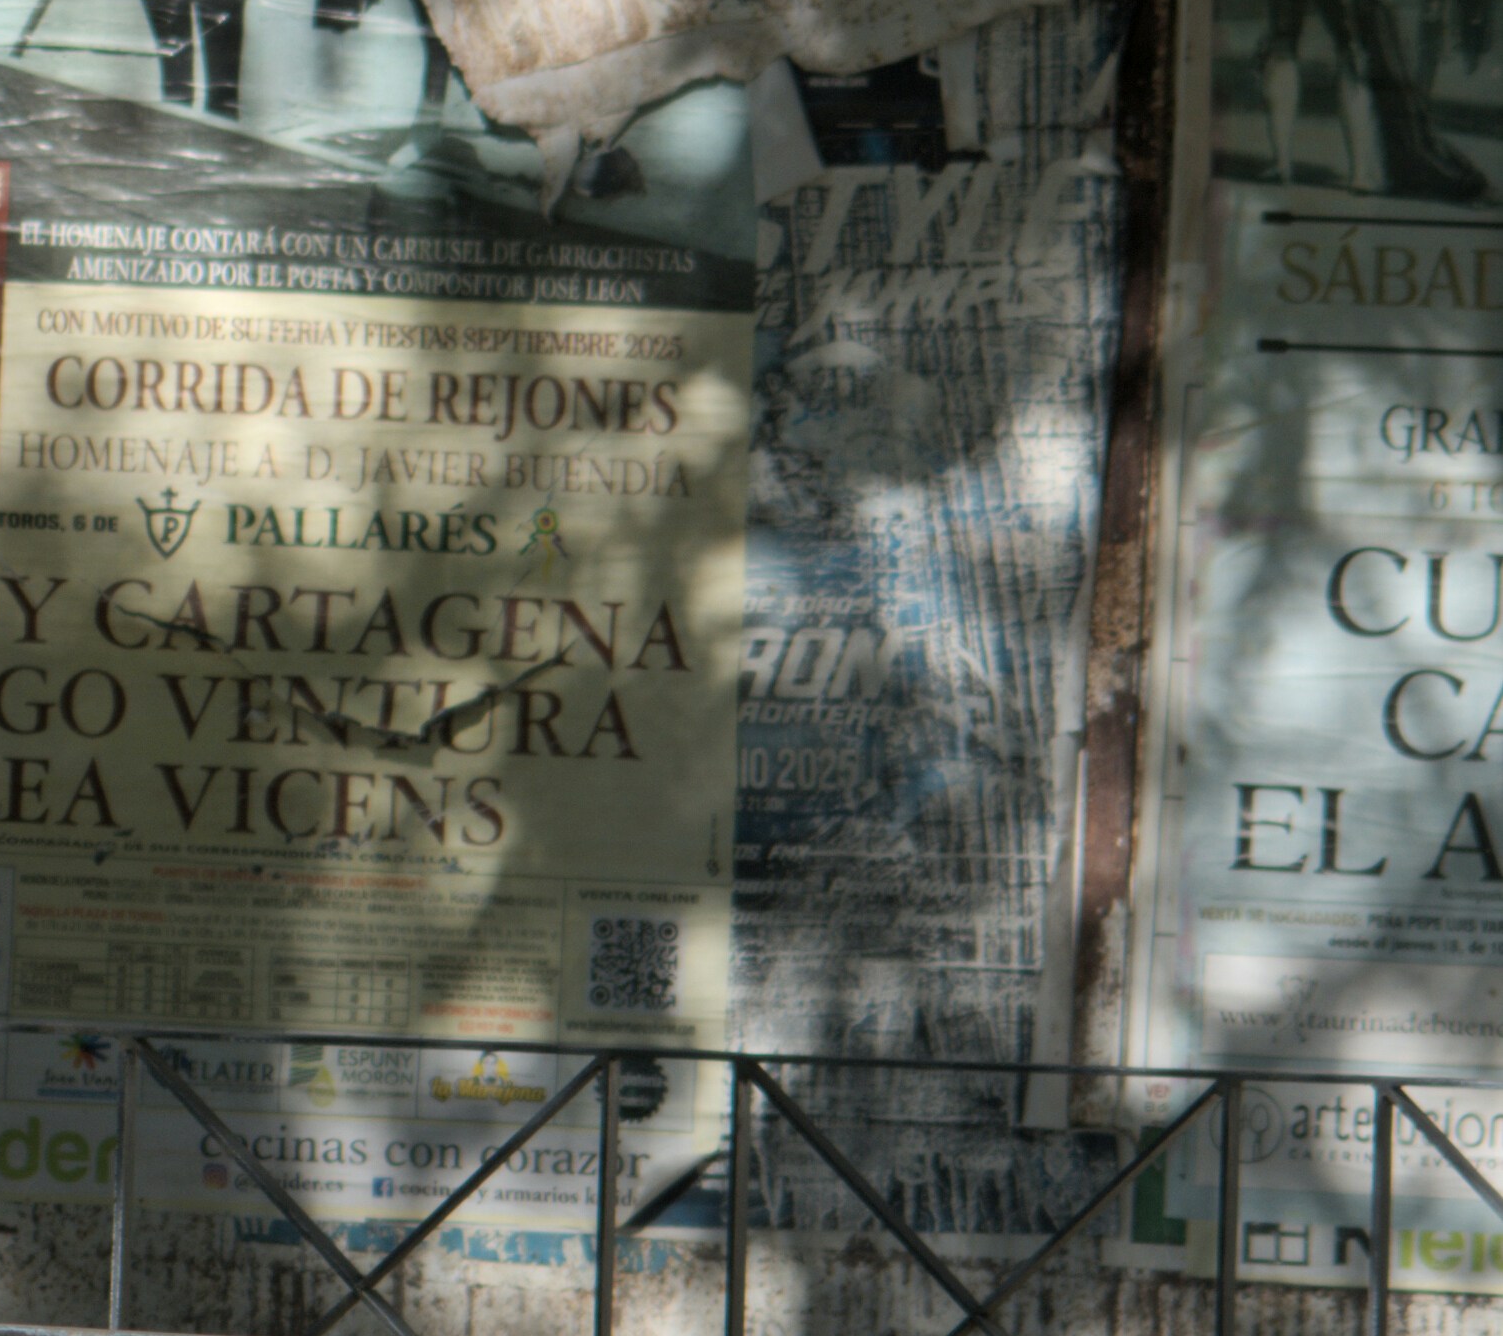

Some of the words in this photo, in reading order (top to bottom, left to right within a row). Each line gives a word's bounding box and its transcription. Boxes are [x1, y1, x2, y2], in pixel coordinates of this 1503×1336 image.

[20, 218, 43, 245] EL
[49, 220, 165, 255] HOMENAJE
[171, 221, 275, 255] CONTARÁ
[281, 231, 329, 257] CON
[333, 233, 369, 259] UN
[373, 234, 485, 264] CARRUSEL
[493, 240, 522, 265] DE
[526, 242, 695, 273] GARROCHISTAS
[67, 256, 203, 282] AMENIZADO
[207, 259, 252, 284] POR
[257, 261, 281, 286] EL
[287, 265, 358, 290] POETA
[362, 267, 379, 291] Y
[383, 268, 527, 299] COMPOSITOR
[532, 277, 580, 304] JOSÉ
[586, 277, 642, 303] LEÓN
[36, 308, 85, 334] CON
[91, 311, 190, 339] MOTIVO
[194, 316, 226, 340] DE
[231, 319, 261, 342] SU
[265, 320, 336, 348] FERIA
[363, 323, 460, 352] FIESTAS
[462, 327, 620, 359] SEPTIEMBRE
[46, 353, 313, 420] CORRIDA
[329, 367, 410, 422] DE
[430, 371, 679, 441] REJONES
[17, 431, 241, 486] HOMENAJE
[249, 444, 279, 479] A
[304, 444, 341, 482] D.
[350, 446, 492, 494] JAVIER
[503, 450, 691, 498] BUENDÍA
[225, 503, 498, 556] PALLARÉS
[93, 578, 693, 674] CARTAGENA
[157, 671, 642, 761] VENTURA
[153, 761, 504, 847] VICENS
[1229, 783, 1387, 877] EL
[336, 1049, 414, 1067] ESPUNY
[199, 1124, 368, 1165] cocinas
[384, 1140, 461, 1170] con
